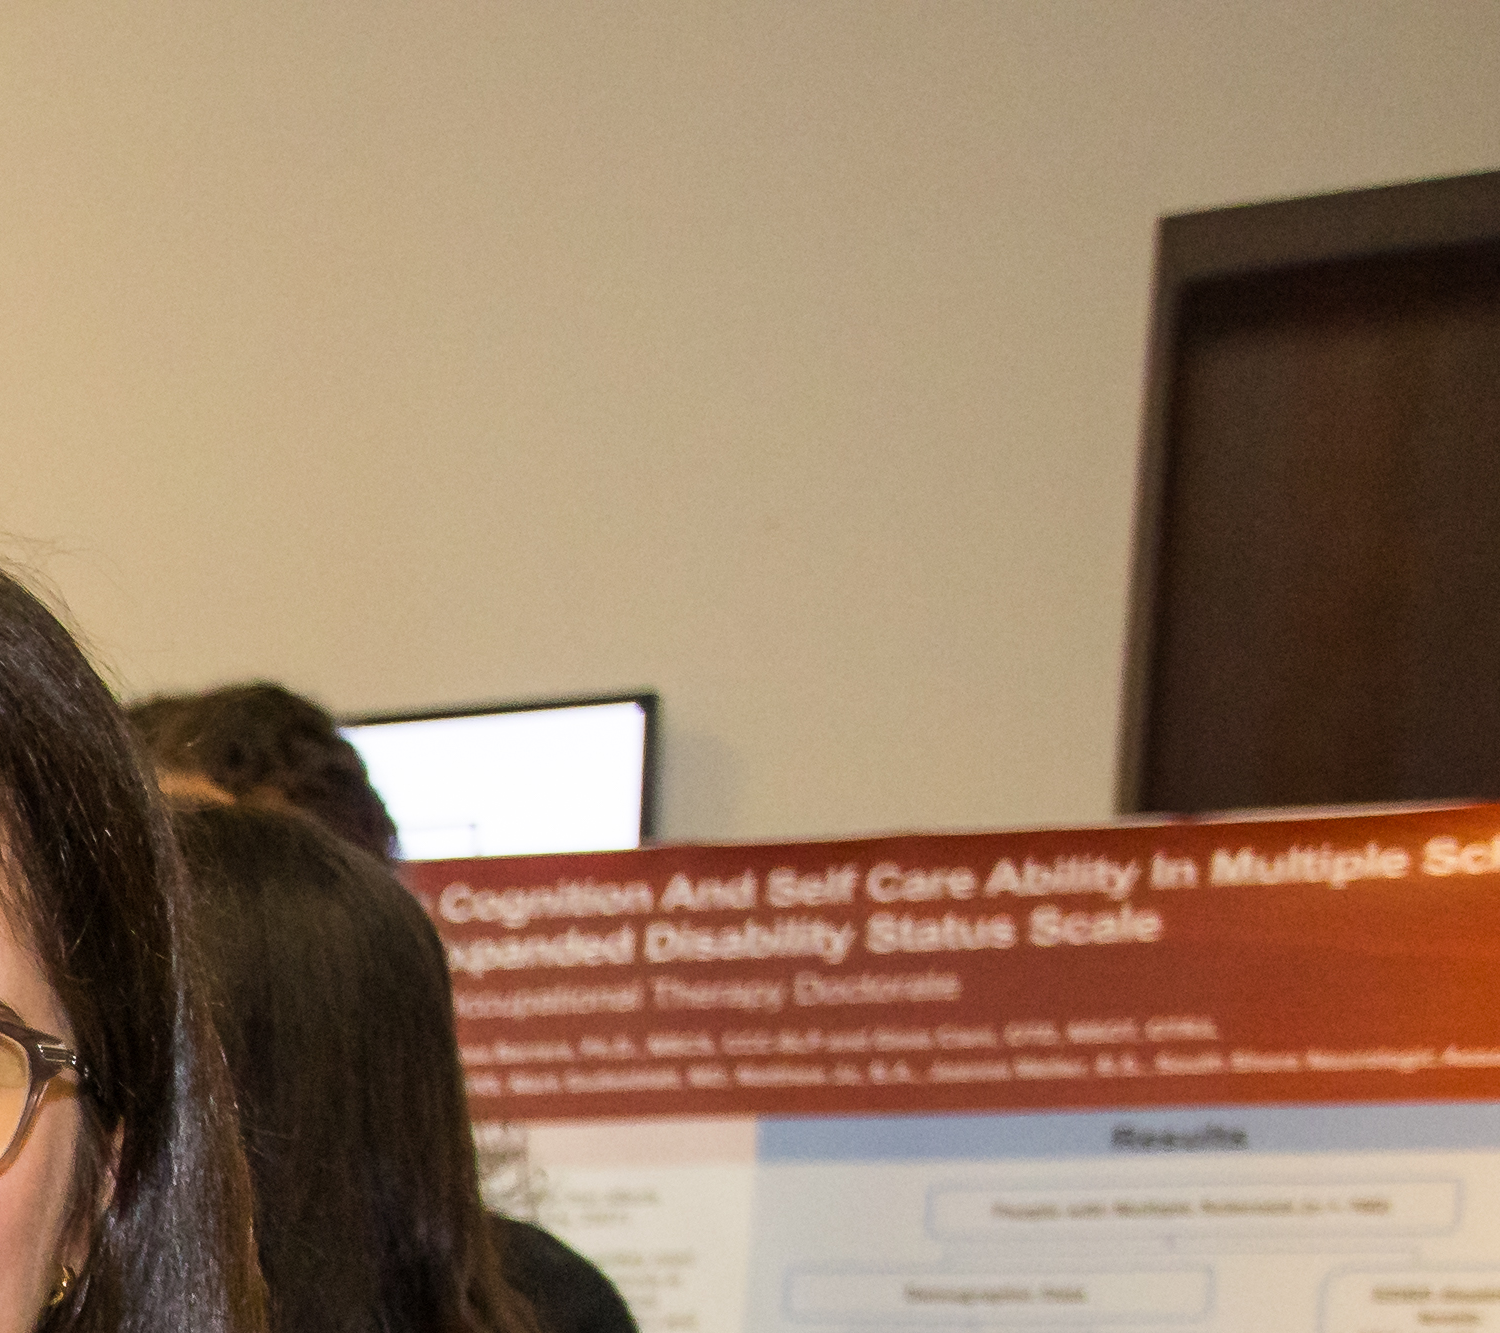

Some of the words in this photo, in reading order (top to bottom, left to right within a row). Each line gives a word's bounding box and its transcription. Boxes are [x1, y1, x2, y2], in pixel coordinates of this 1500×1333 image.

[439, 876, 655, 928] Cognition
[660, 870, 759, 913] And
[766, 864, 861, 908] Self
[866, 858, 977, 901] Care
[985, 854, 1141, 900] Ability
[1149, 850, 1198, 891] In
[1210, 840, 1409, 890] Multiple
[449, 926, 635, 977] xpanded
[643, 918, 857, 965] Disability
[865, 908, 1017, 953] Status
[1029, 901, 1163, 948] Scale
